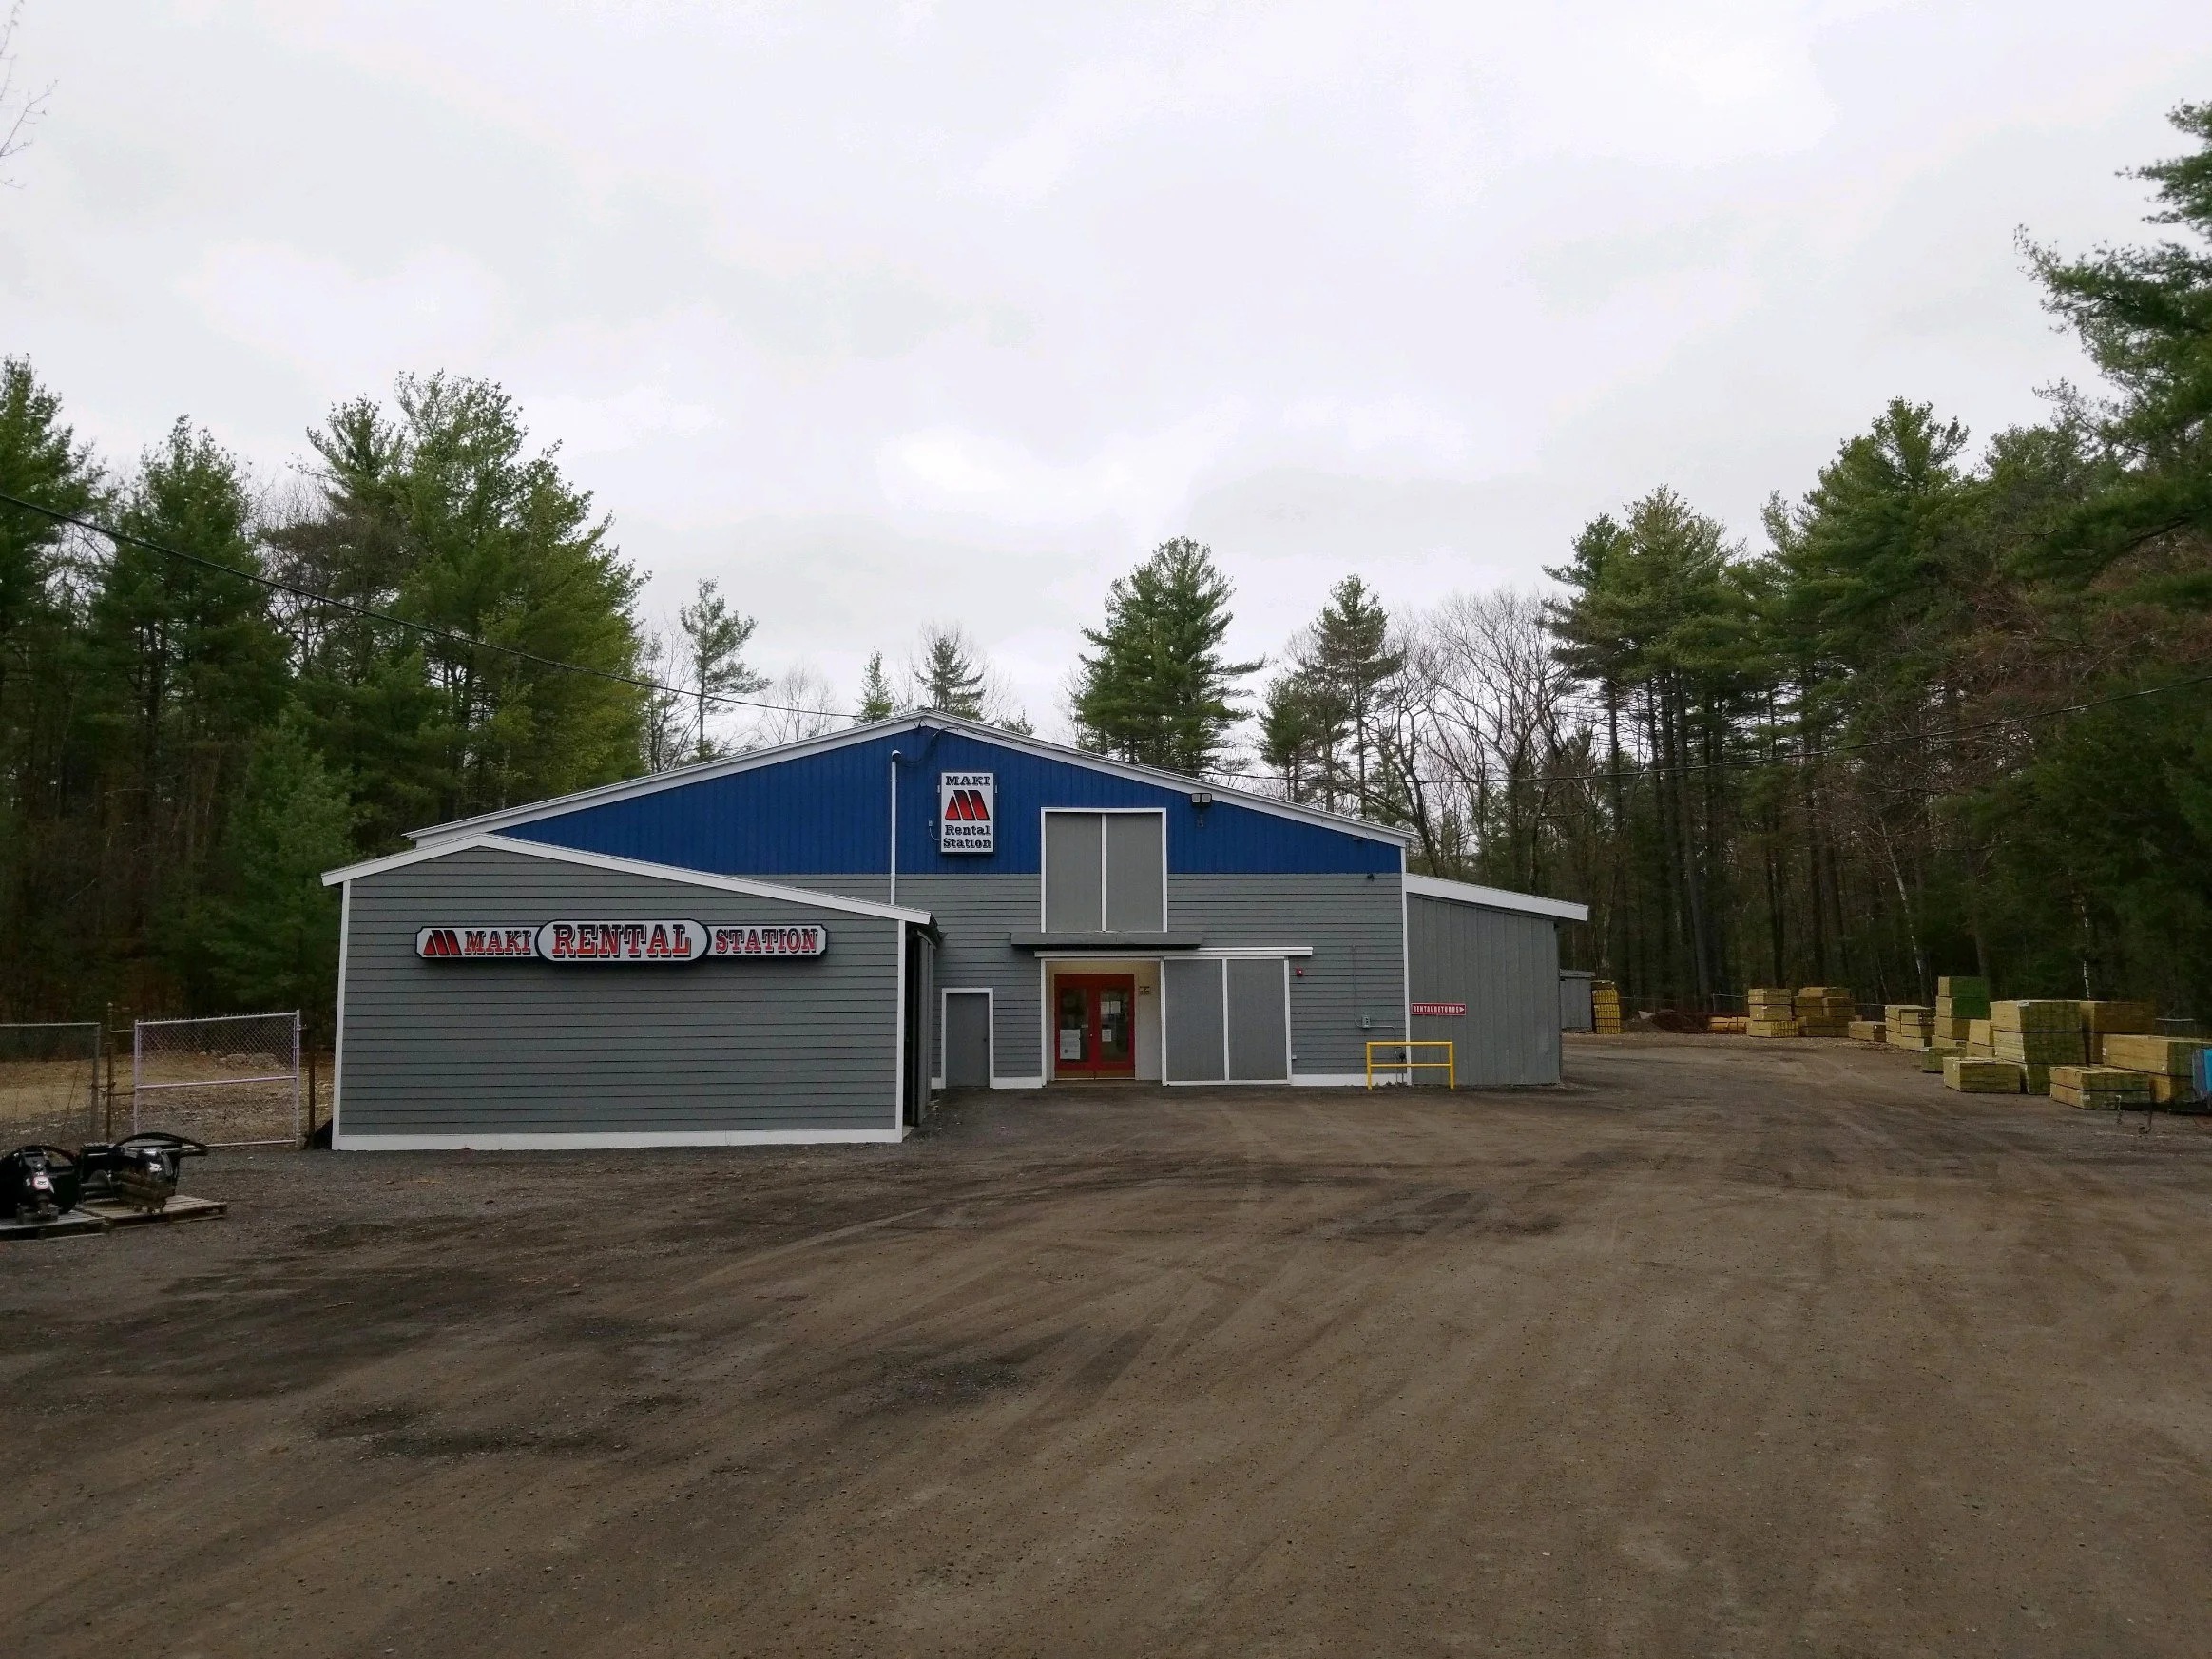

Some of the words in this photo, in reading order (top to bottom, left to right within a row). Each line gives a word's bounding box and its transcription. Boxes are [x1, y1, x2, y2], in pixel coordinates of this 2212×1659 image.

[945, 776, 990, 786] MAKI
[945, 824, 991, 836] Rental
[943, 838, 992, 848] Station
[464, 930, 531, 955] MAKI
[551, 924, 691, 958] RENTAL
[715, 928, 818, 954] STATION
